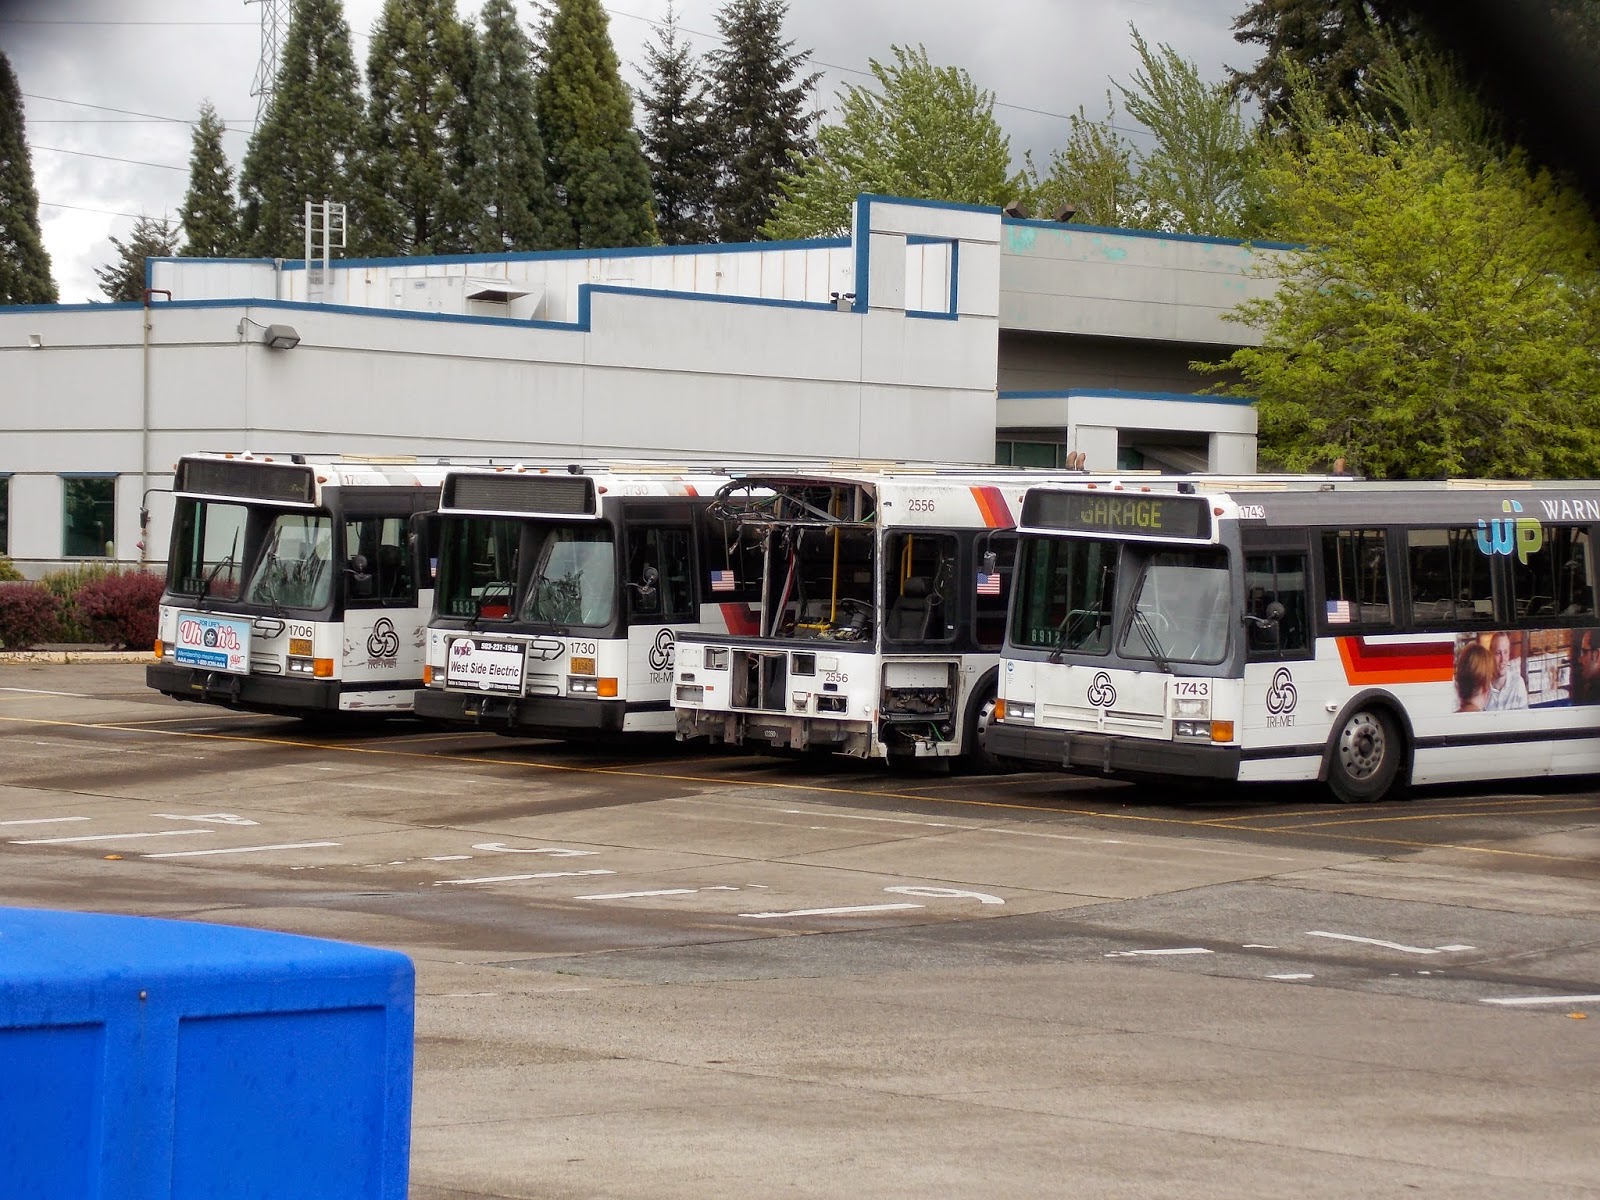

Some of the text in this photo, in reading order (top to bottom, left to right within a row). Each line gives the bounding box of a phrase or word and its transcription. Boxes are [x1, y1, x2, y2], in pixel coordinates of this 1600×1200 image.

[908, 499, 935, 512] 2556
[1241, 505, 1265, 519] 1743
[1540, 499, 1600, 520] WARN
[288, 624, 313, 638] 1706
[570, 642, 596, 655] 1730
[450, 661, 520, 677] West Side Electric
[649, 671, 674, 683] TRI-M
[825, 671, 849, 683] 2556
[1173, 682, 1209, 696] 1743
[1266, 714, 1296, 728] TRI-MET
